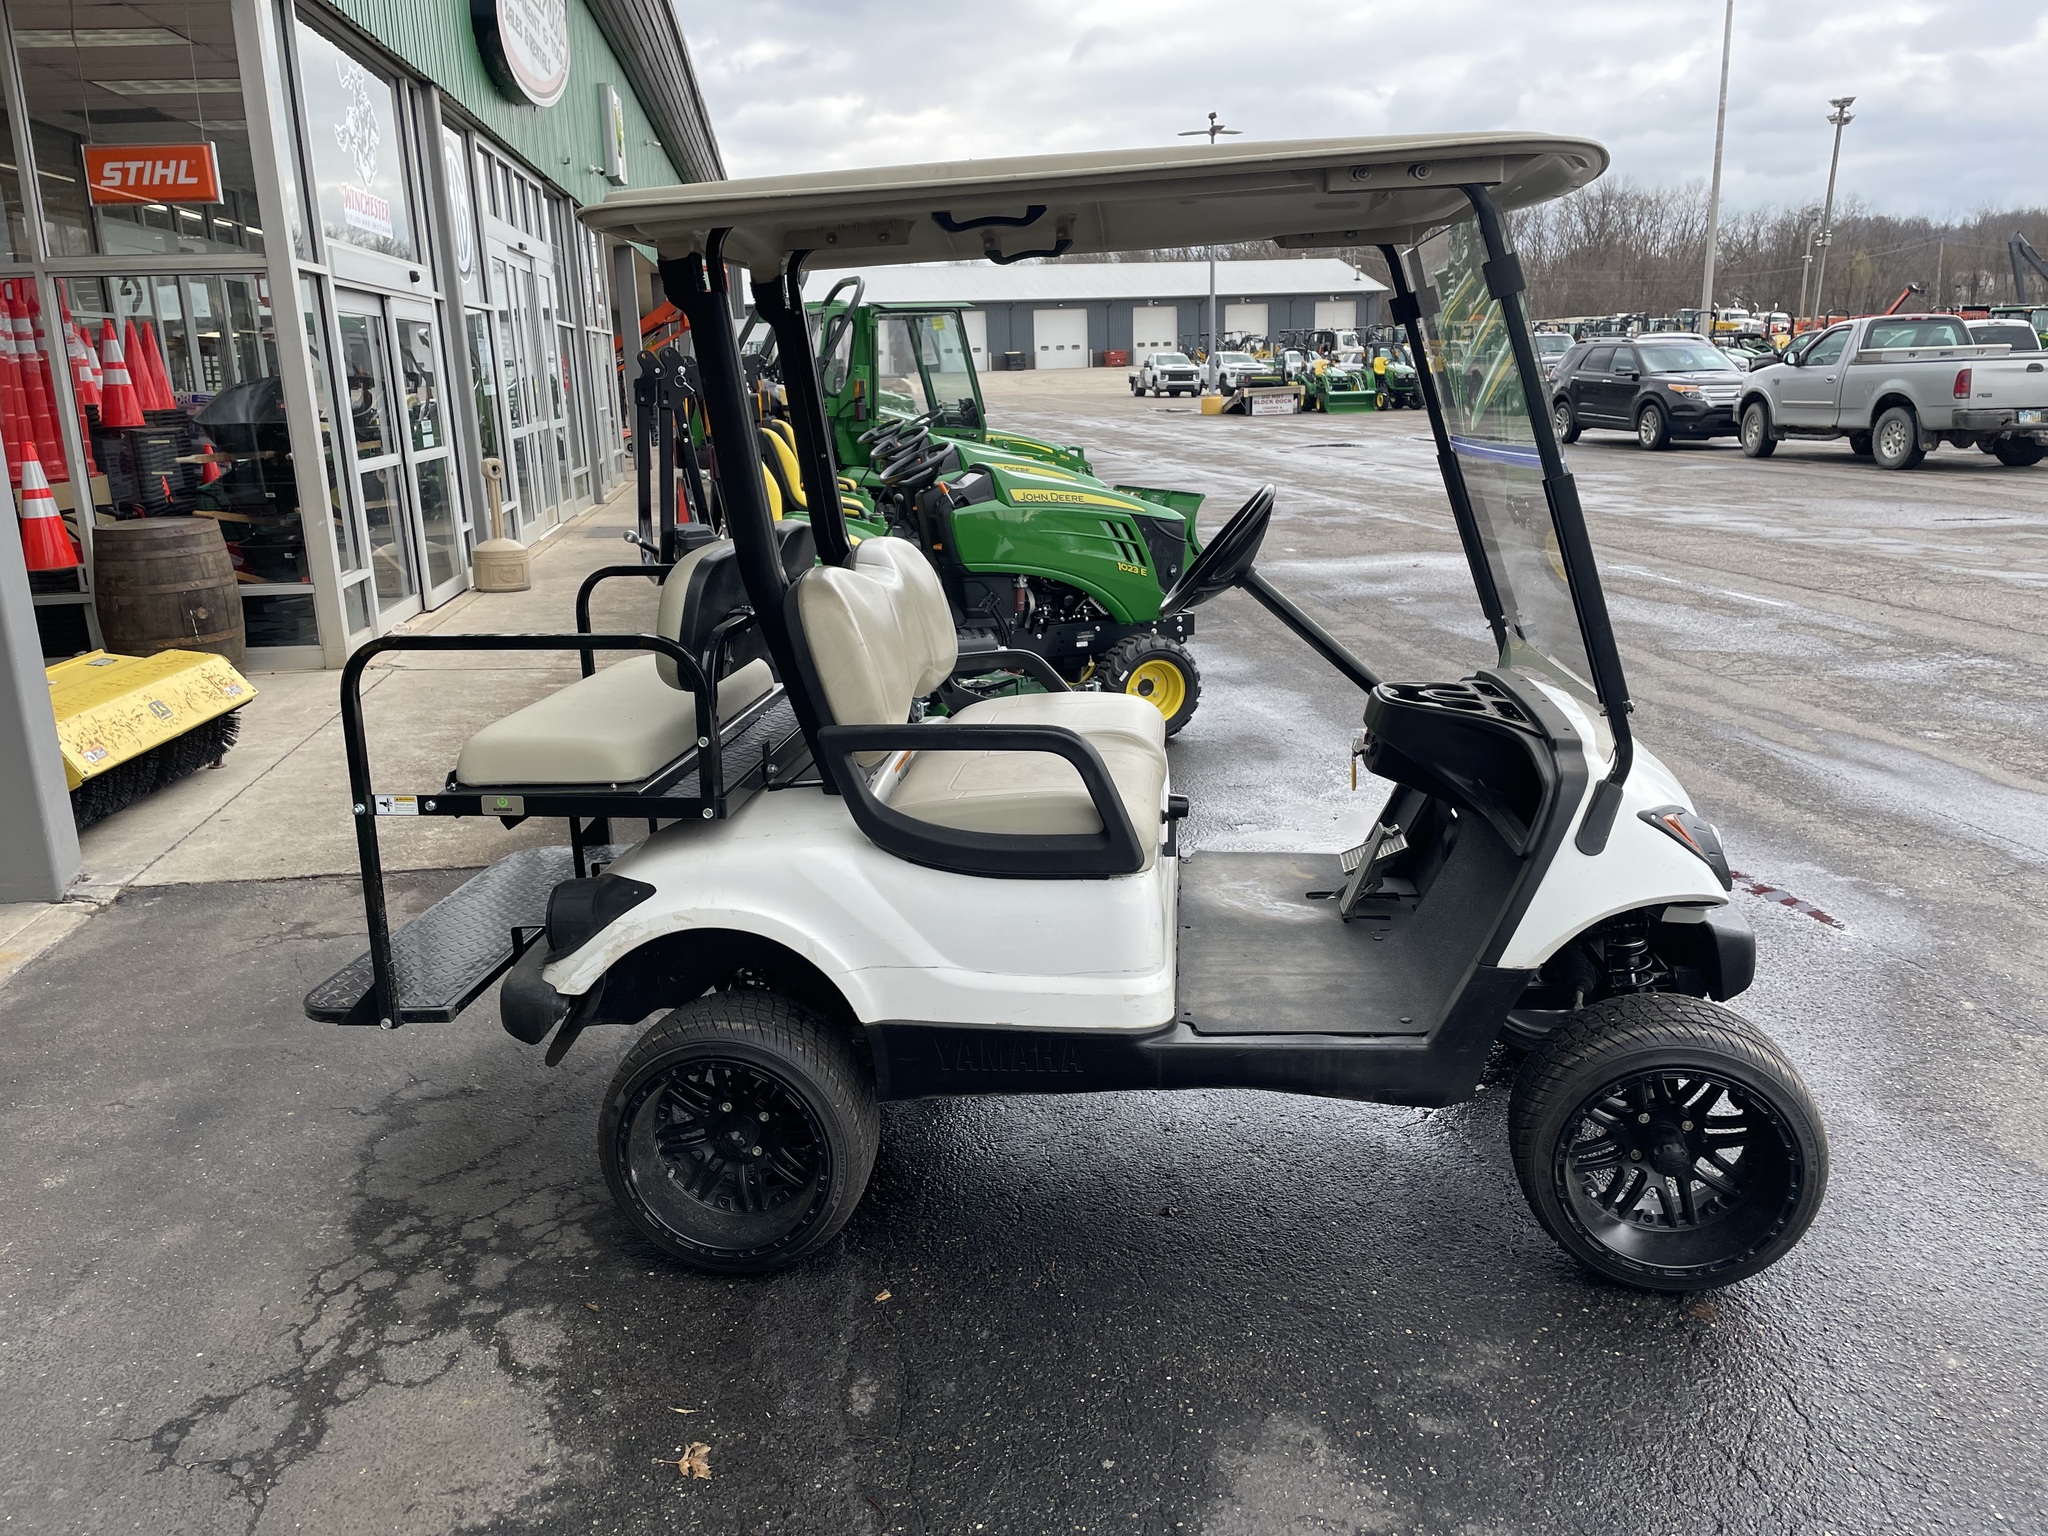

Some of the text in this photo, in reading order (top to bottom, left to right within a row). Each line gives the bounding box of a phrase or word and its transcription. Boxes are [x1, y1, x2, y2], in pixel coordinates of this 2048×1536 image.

[100, 160, 199, 187] STIHL
[342, 185, 391, 224] WINCHESTER
[1020, 492, 1085, 503] JOHN DEERE
[1117, 562, 1139, 574] 1023
[933, 1037, 1085, 1073] YAMAHA
